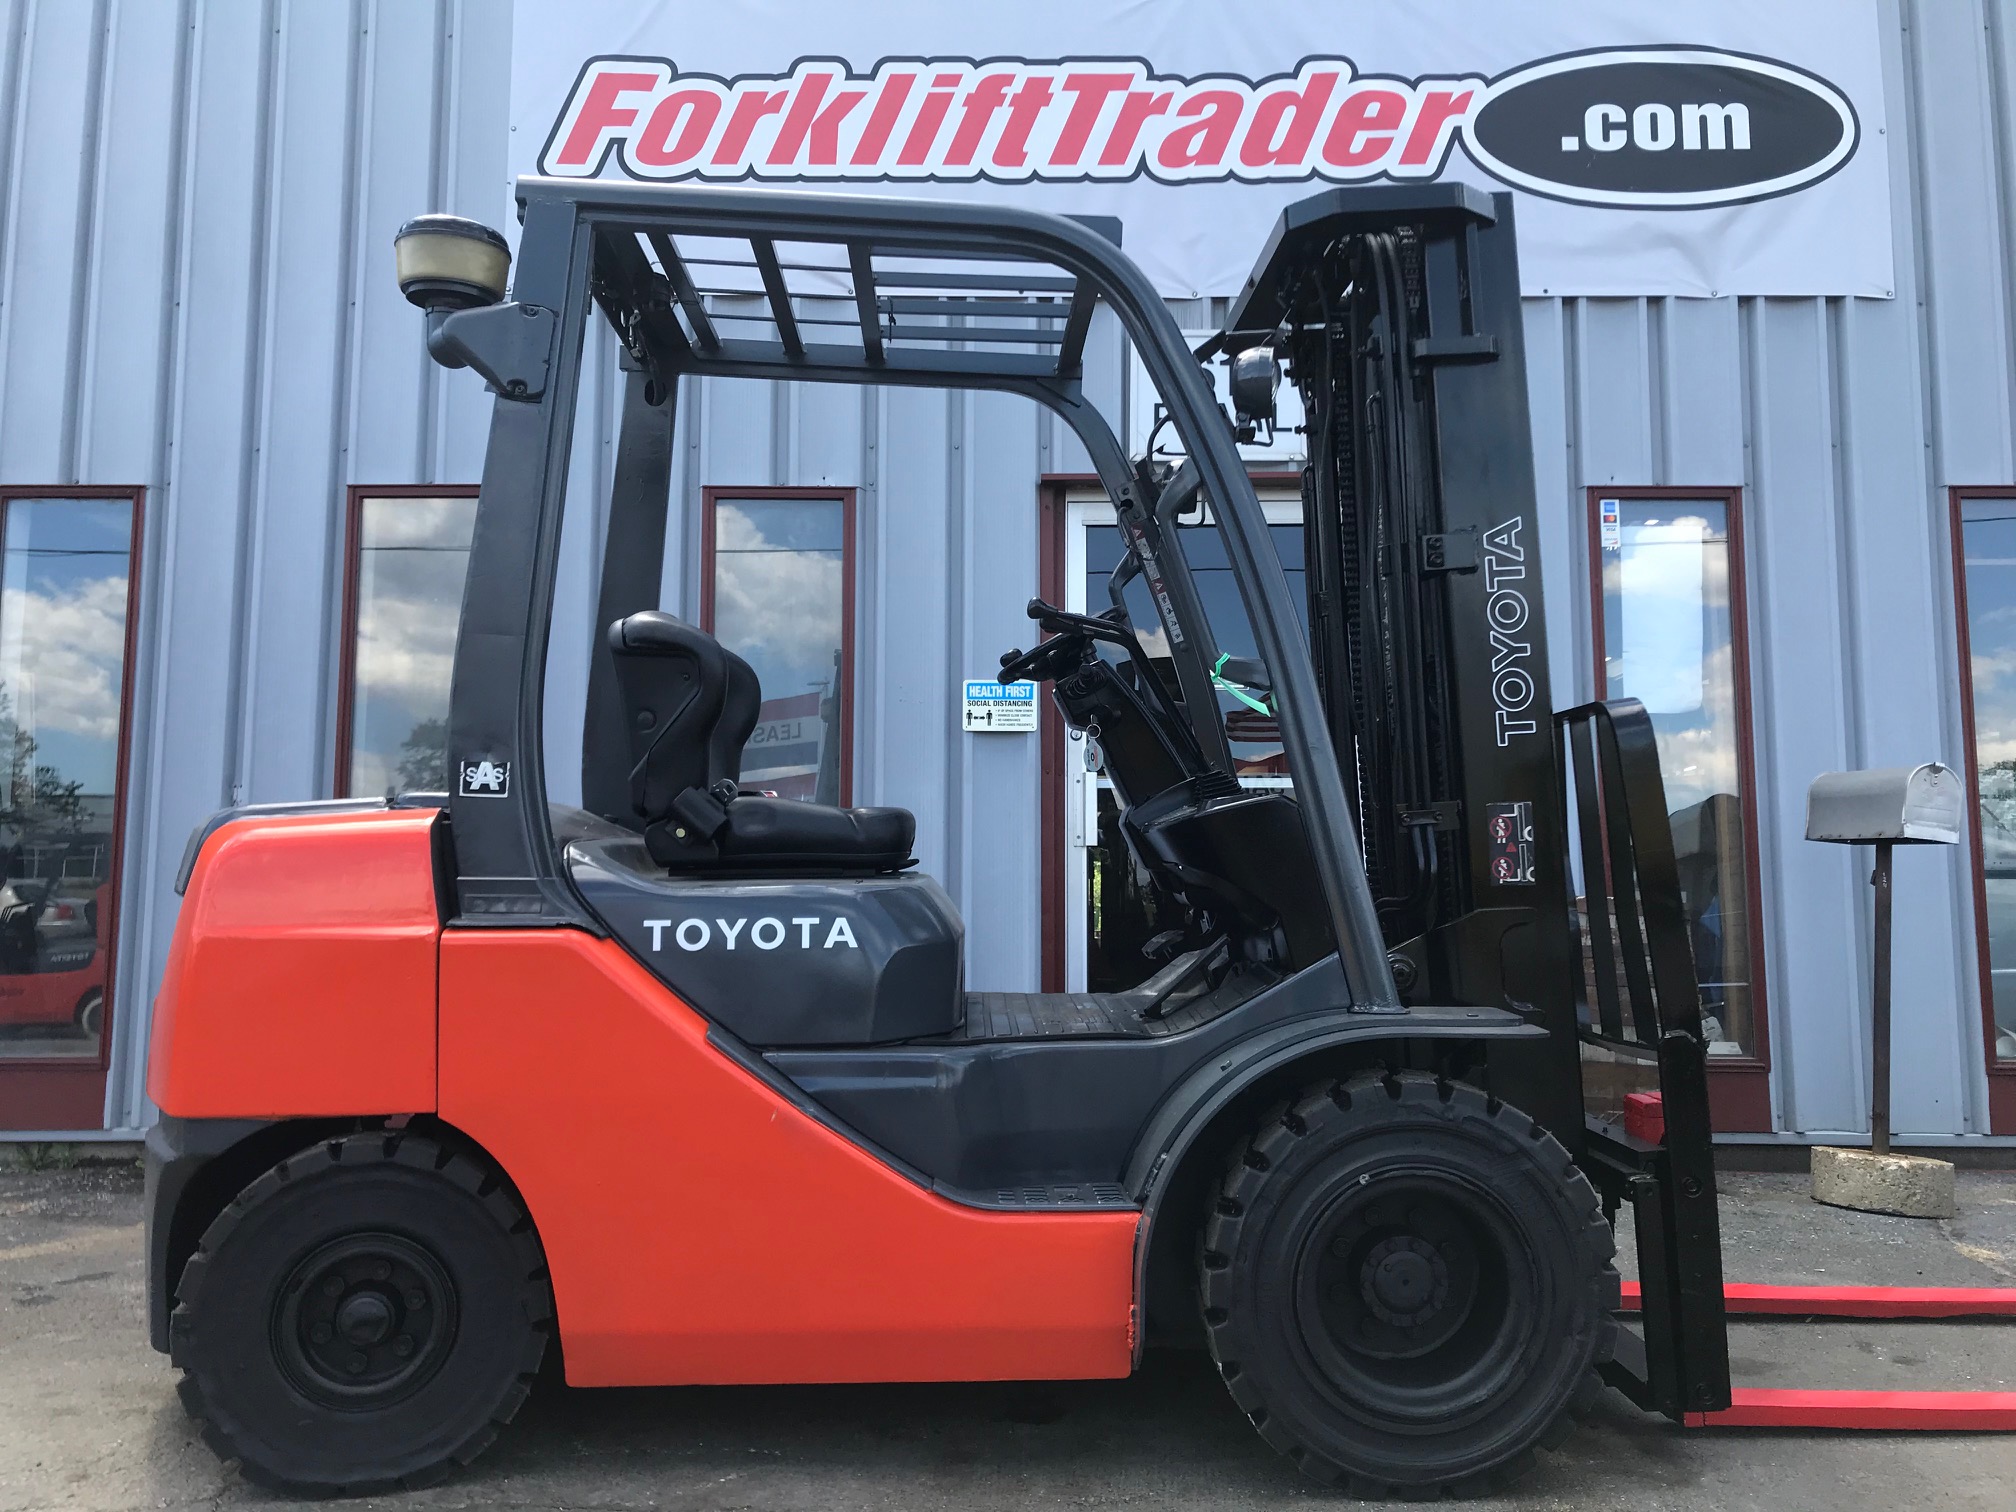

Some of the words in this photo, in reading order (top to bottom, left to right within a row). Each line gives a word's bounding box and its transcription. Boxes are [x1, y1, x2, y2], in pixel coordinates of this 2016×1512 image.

[1483, 515, 1537, 747] TOYOTA
[969, 685, 1002, 698] HEALTH
[1006, 685, 1031, 698] FIRST
[465, 761, 504, 791] SAS
[643, 916, 859, 952] TOYOTA
